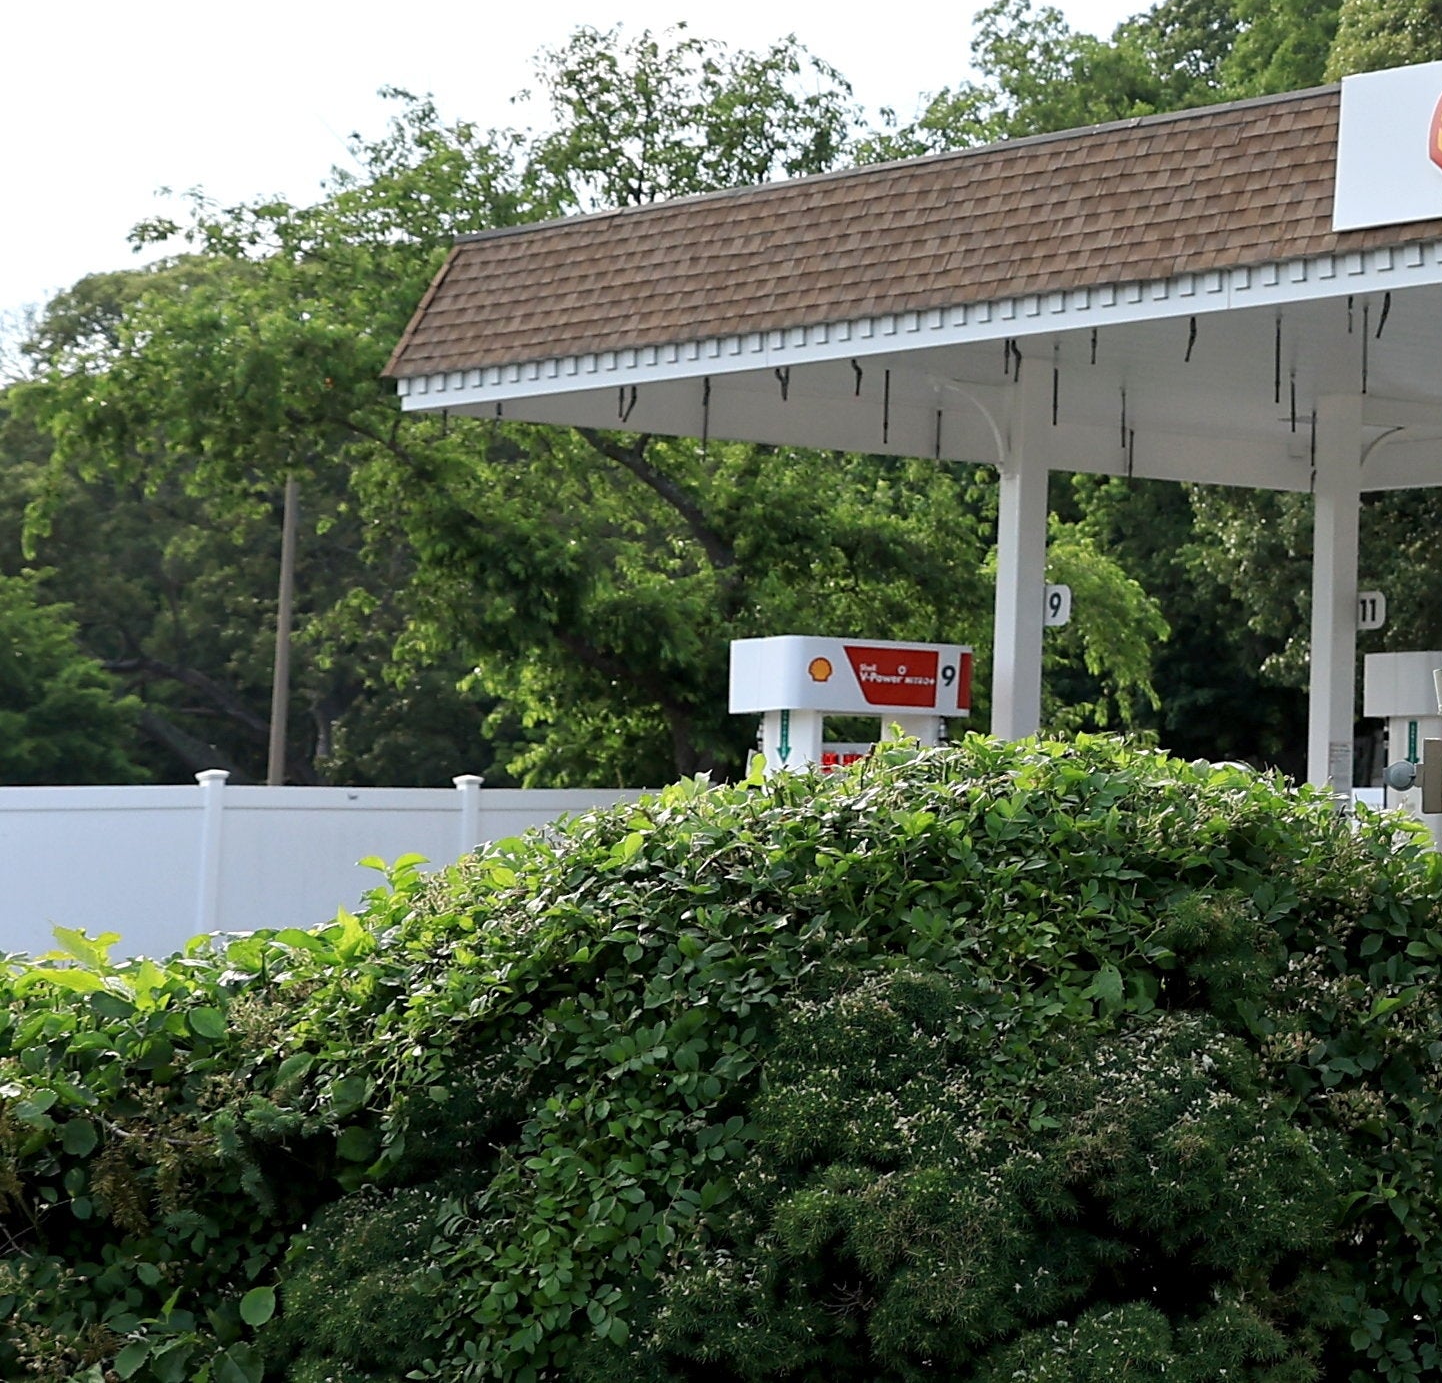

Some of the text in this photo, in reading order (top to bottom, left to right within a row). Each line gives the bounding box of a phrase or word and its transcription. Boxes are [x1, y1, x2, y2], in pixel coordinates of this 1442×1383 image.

[1050, 592, 1061, 618] 9
[1360, 599, 1376, 622] 11
[941, 665, 956, 687] 9
